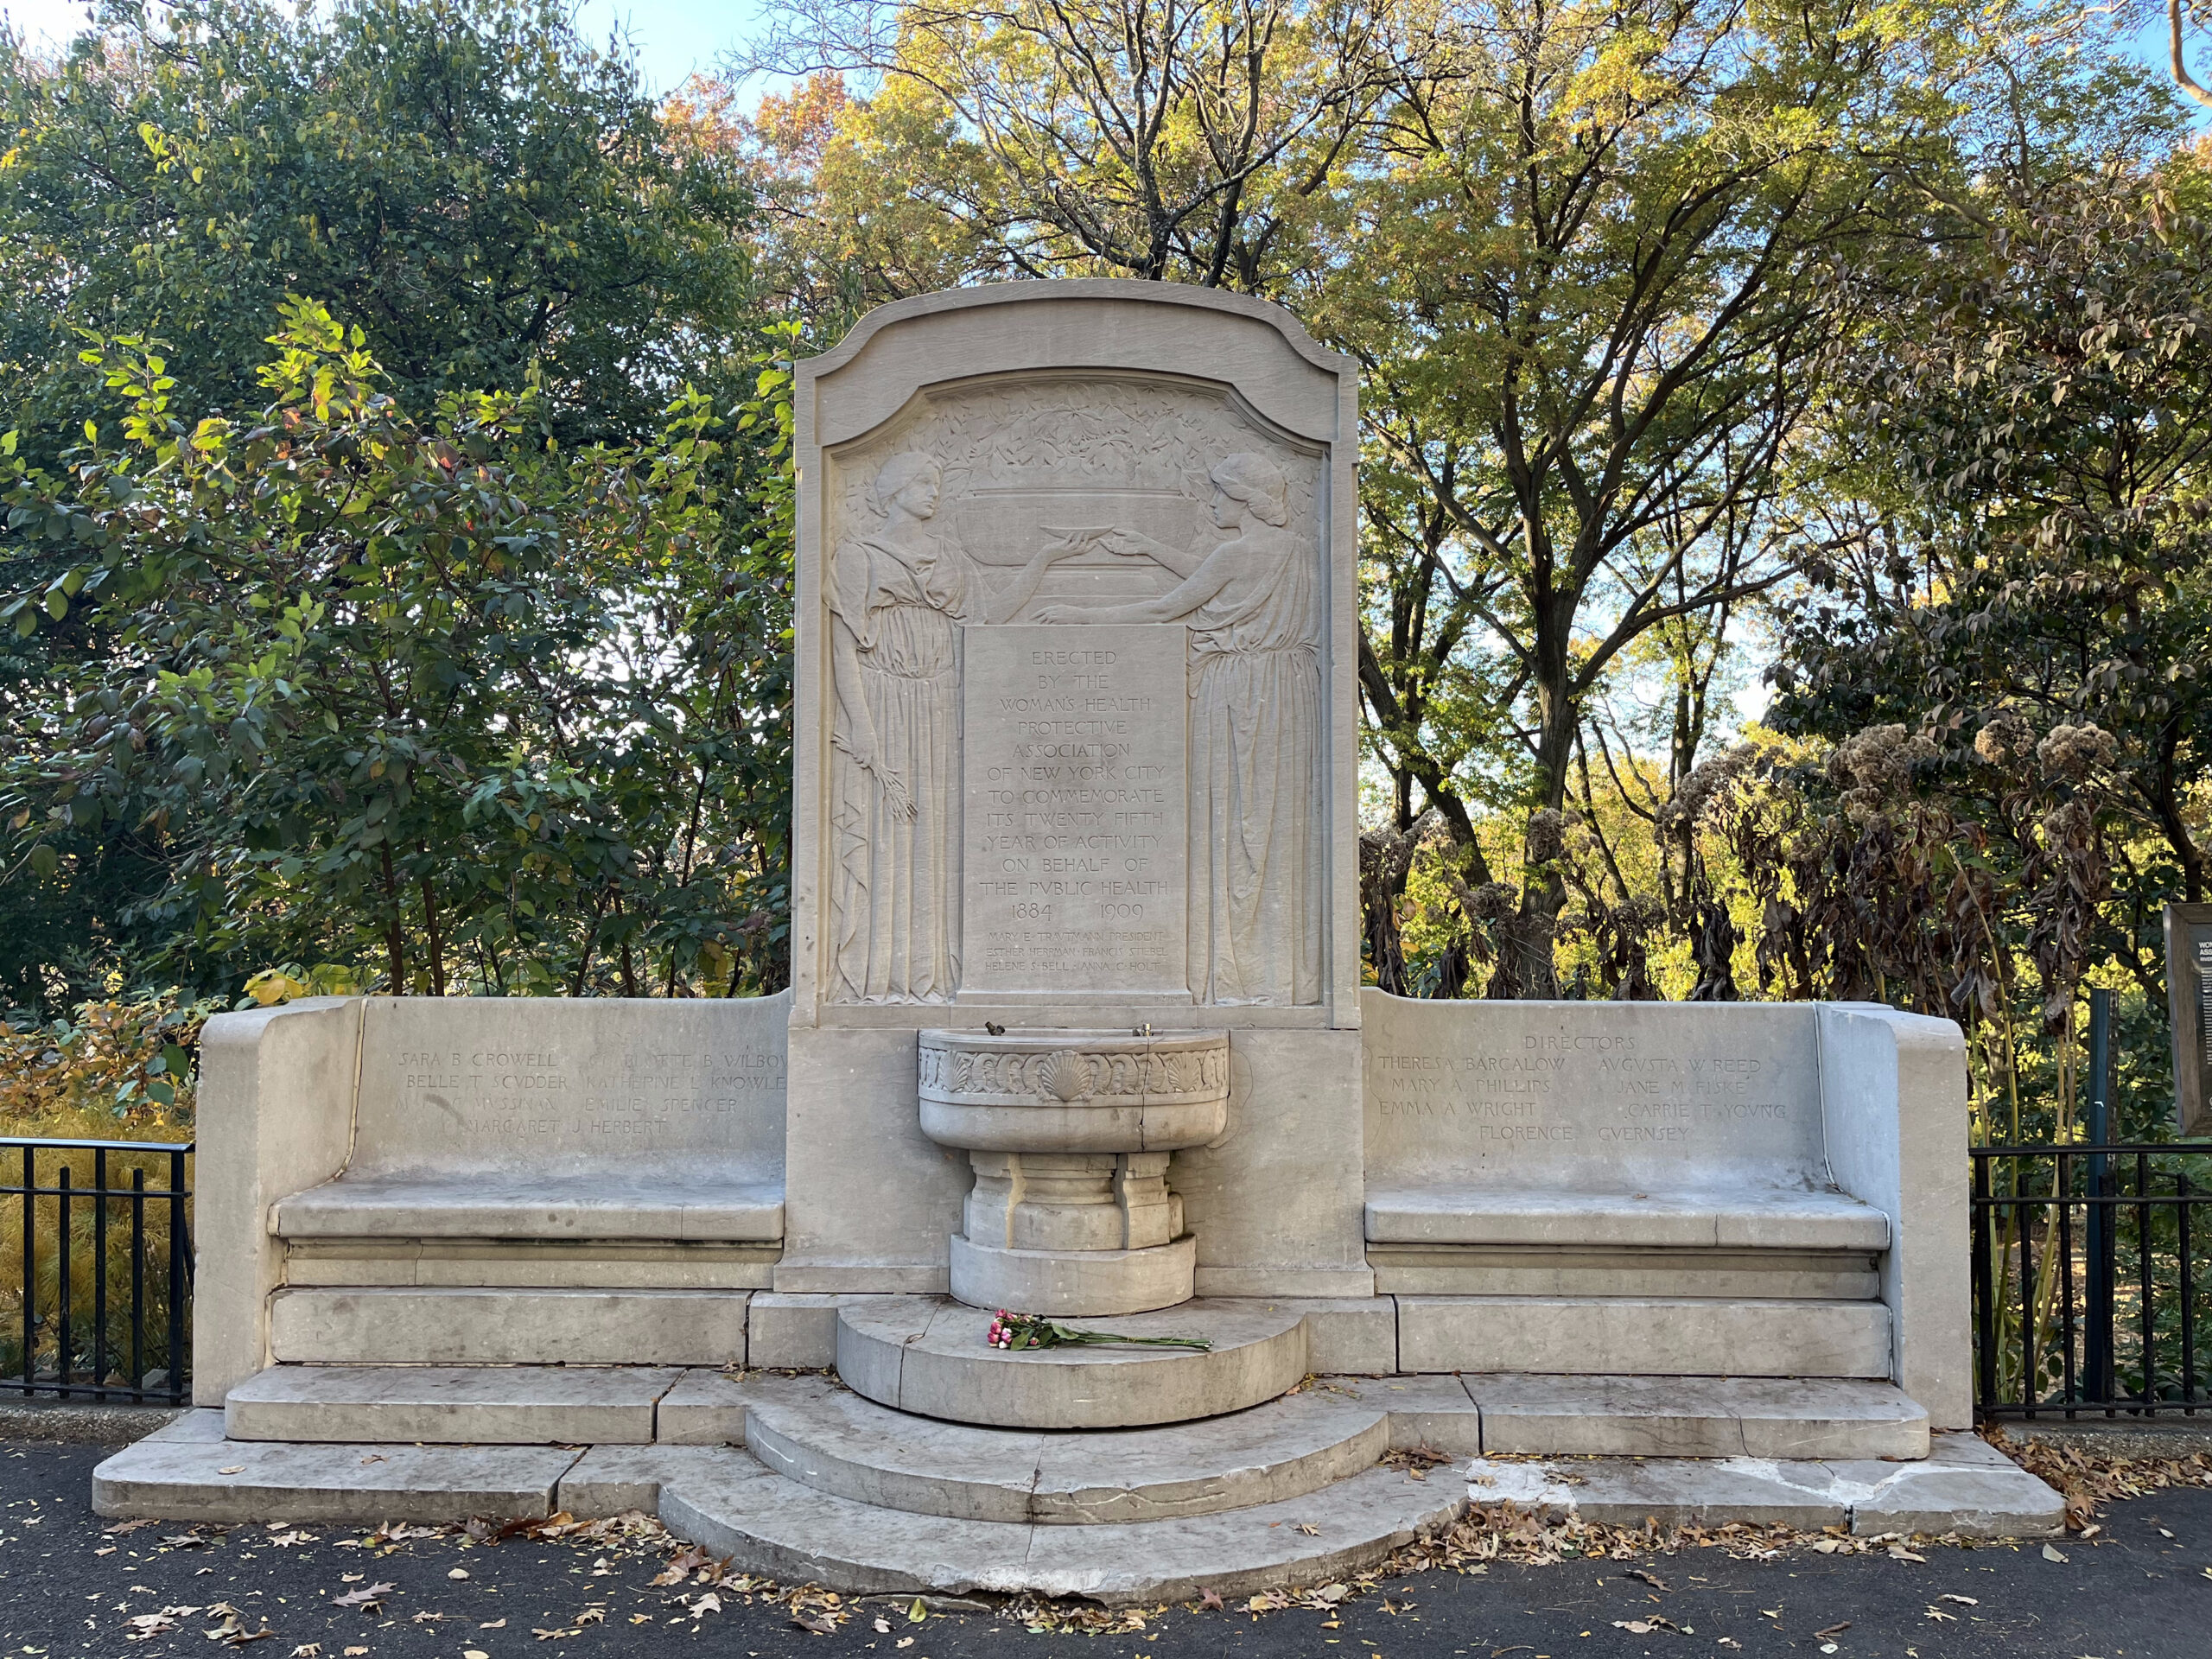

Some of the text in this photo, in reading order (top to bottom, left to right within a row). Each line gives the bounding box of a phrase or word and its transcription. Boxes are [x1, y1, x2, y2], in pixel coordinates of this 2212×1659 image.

[1033, 652, 1116, 665] ERECTED
[1038, 675, 1109, 690] BY THE
[1000, 696, 1150, 712] WOMAN'S HEALTH
[1018, 721, 1127, 735] PROTECTIVE
[1012, 743, 1130, 758] ASSOCIATION
[988, 766, 1166, 781] OF NEW YORK CITY
[988, 789, 1165, 804] TO COMMEMORATE
[987, 812, 1163, 827] ITS TWENTY FIFTH
[987, 836, 1163, 850] YEAR OF ACTIVITY
[1002, 858, 1148, 872] ON BEHALF OF
[979, 882, 1018, 896] THE
[1101, 880, 1167, 896] HEALTH
[1012, 902, 1143, 922] 1884 1909
[988, 931, 1019, 943] MARY
[1109, 931, 1164, 943] PRESIDENT
[986, 947, 1025, 957] ESTHER
[1083, 947, 1122, 957] FRANCIS
[1128, 947, 1169, 957] STIEBEL
[985, 962, 1026, 971] HELENE
[1080, 962, 1109, 971] ANNA
[1129, 962, 1161, 971] HOLT
[1525, 1036, 1635, 1050] DIRECTORS
[398, 1052, 557, 1067] SARA B CROWELL
[703, 1054, 713, 1067] B
[1378, 1056, 1565, 1071] THERESA BARCALOW
[1713, 1059, 1761, 1072] REED
[407, 1074, 460, 1088] BELLE
[469, 1075, 483, 1088] T
[586, 1076, 680, 1090] KATHERINE
[691, 1077, 699, 1090] L
[1391, 1078, 1550, 1093] MARY A PHILLIPS
[1618, 1081, 1747, 1094] JANE M FISKE
[585, 1098, 737, 1112] EMILIE SPENCER
[1380, 1101, 1536, 1116] EMMA A WRIGHT
[1628, 1103, 1690, 1118] CARRIE
[1700, 1104, 1713, 1117] T
[468, 1119, 667, 1135] MARGARET J HERBERT
[1480, 1126, 1573, 1141] FLORENCE
